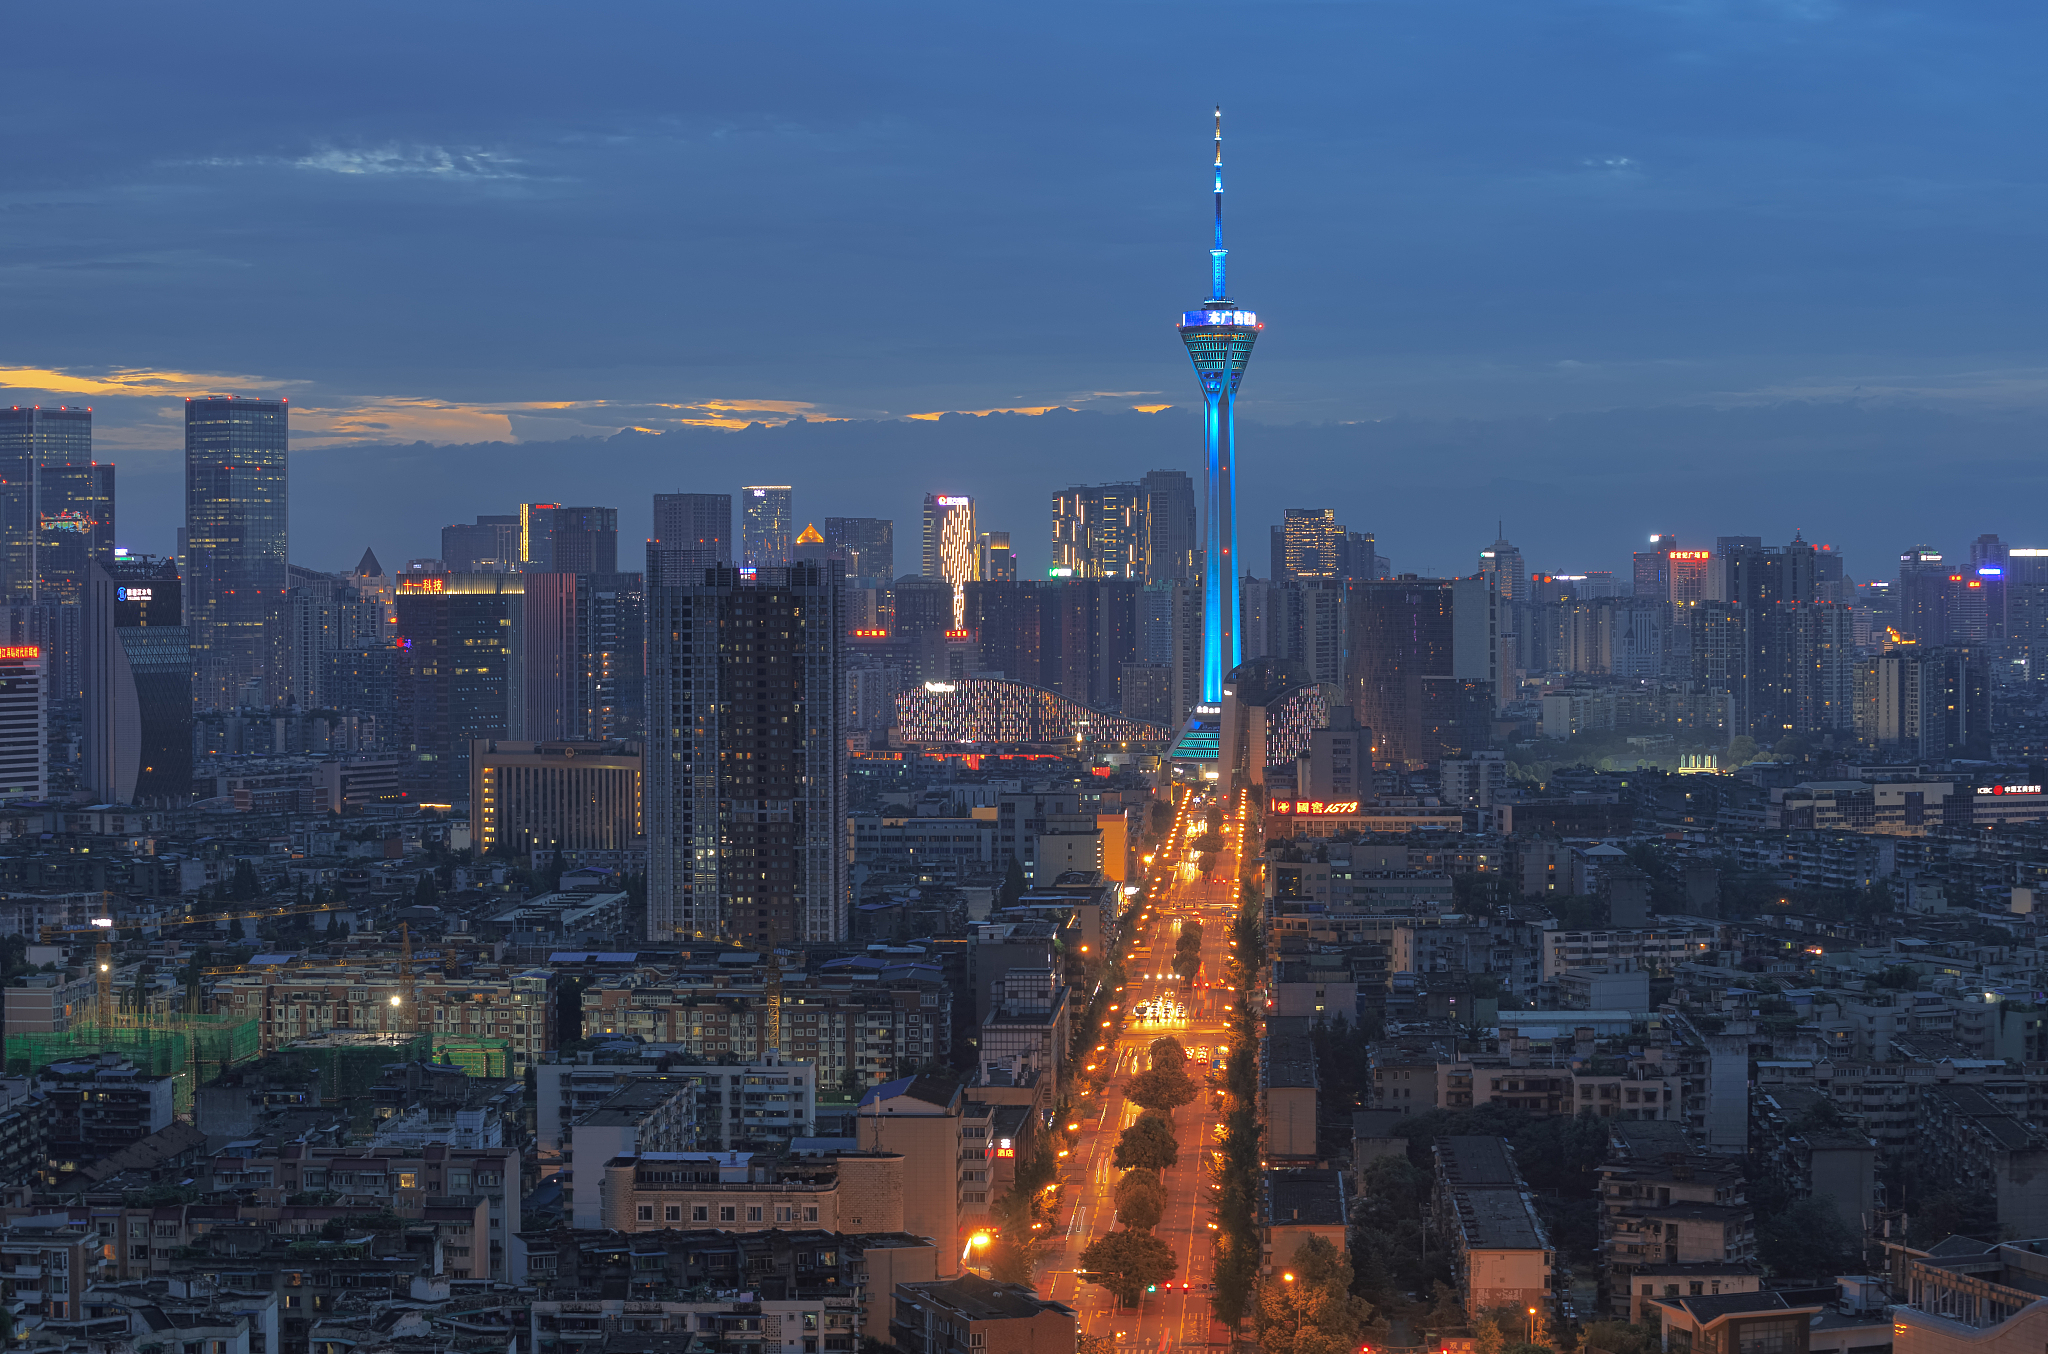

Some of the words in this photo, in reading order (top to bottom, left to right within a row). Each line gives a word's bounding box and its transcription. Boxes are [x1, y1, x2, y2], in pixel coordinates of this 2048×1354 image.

[1669, 551, 1701, 559] 新世纪广场
[403, 579, 443, 591] 十一科技
[2004, 785, 2041, 793] 中国工商银行
[997, 1148, 1014, 1157] 酒店
